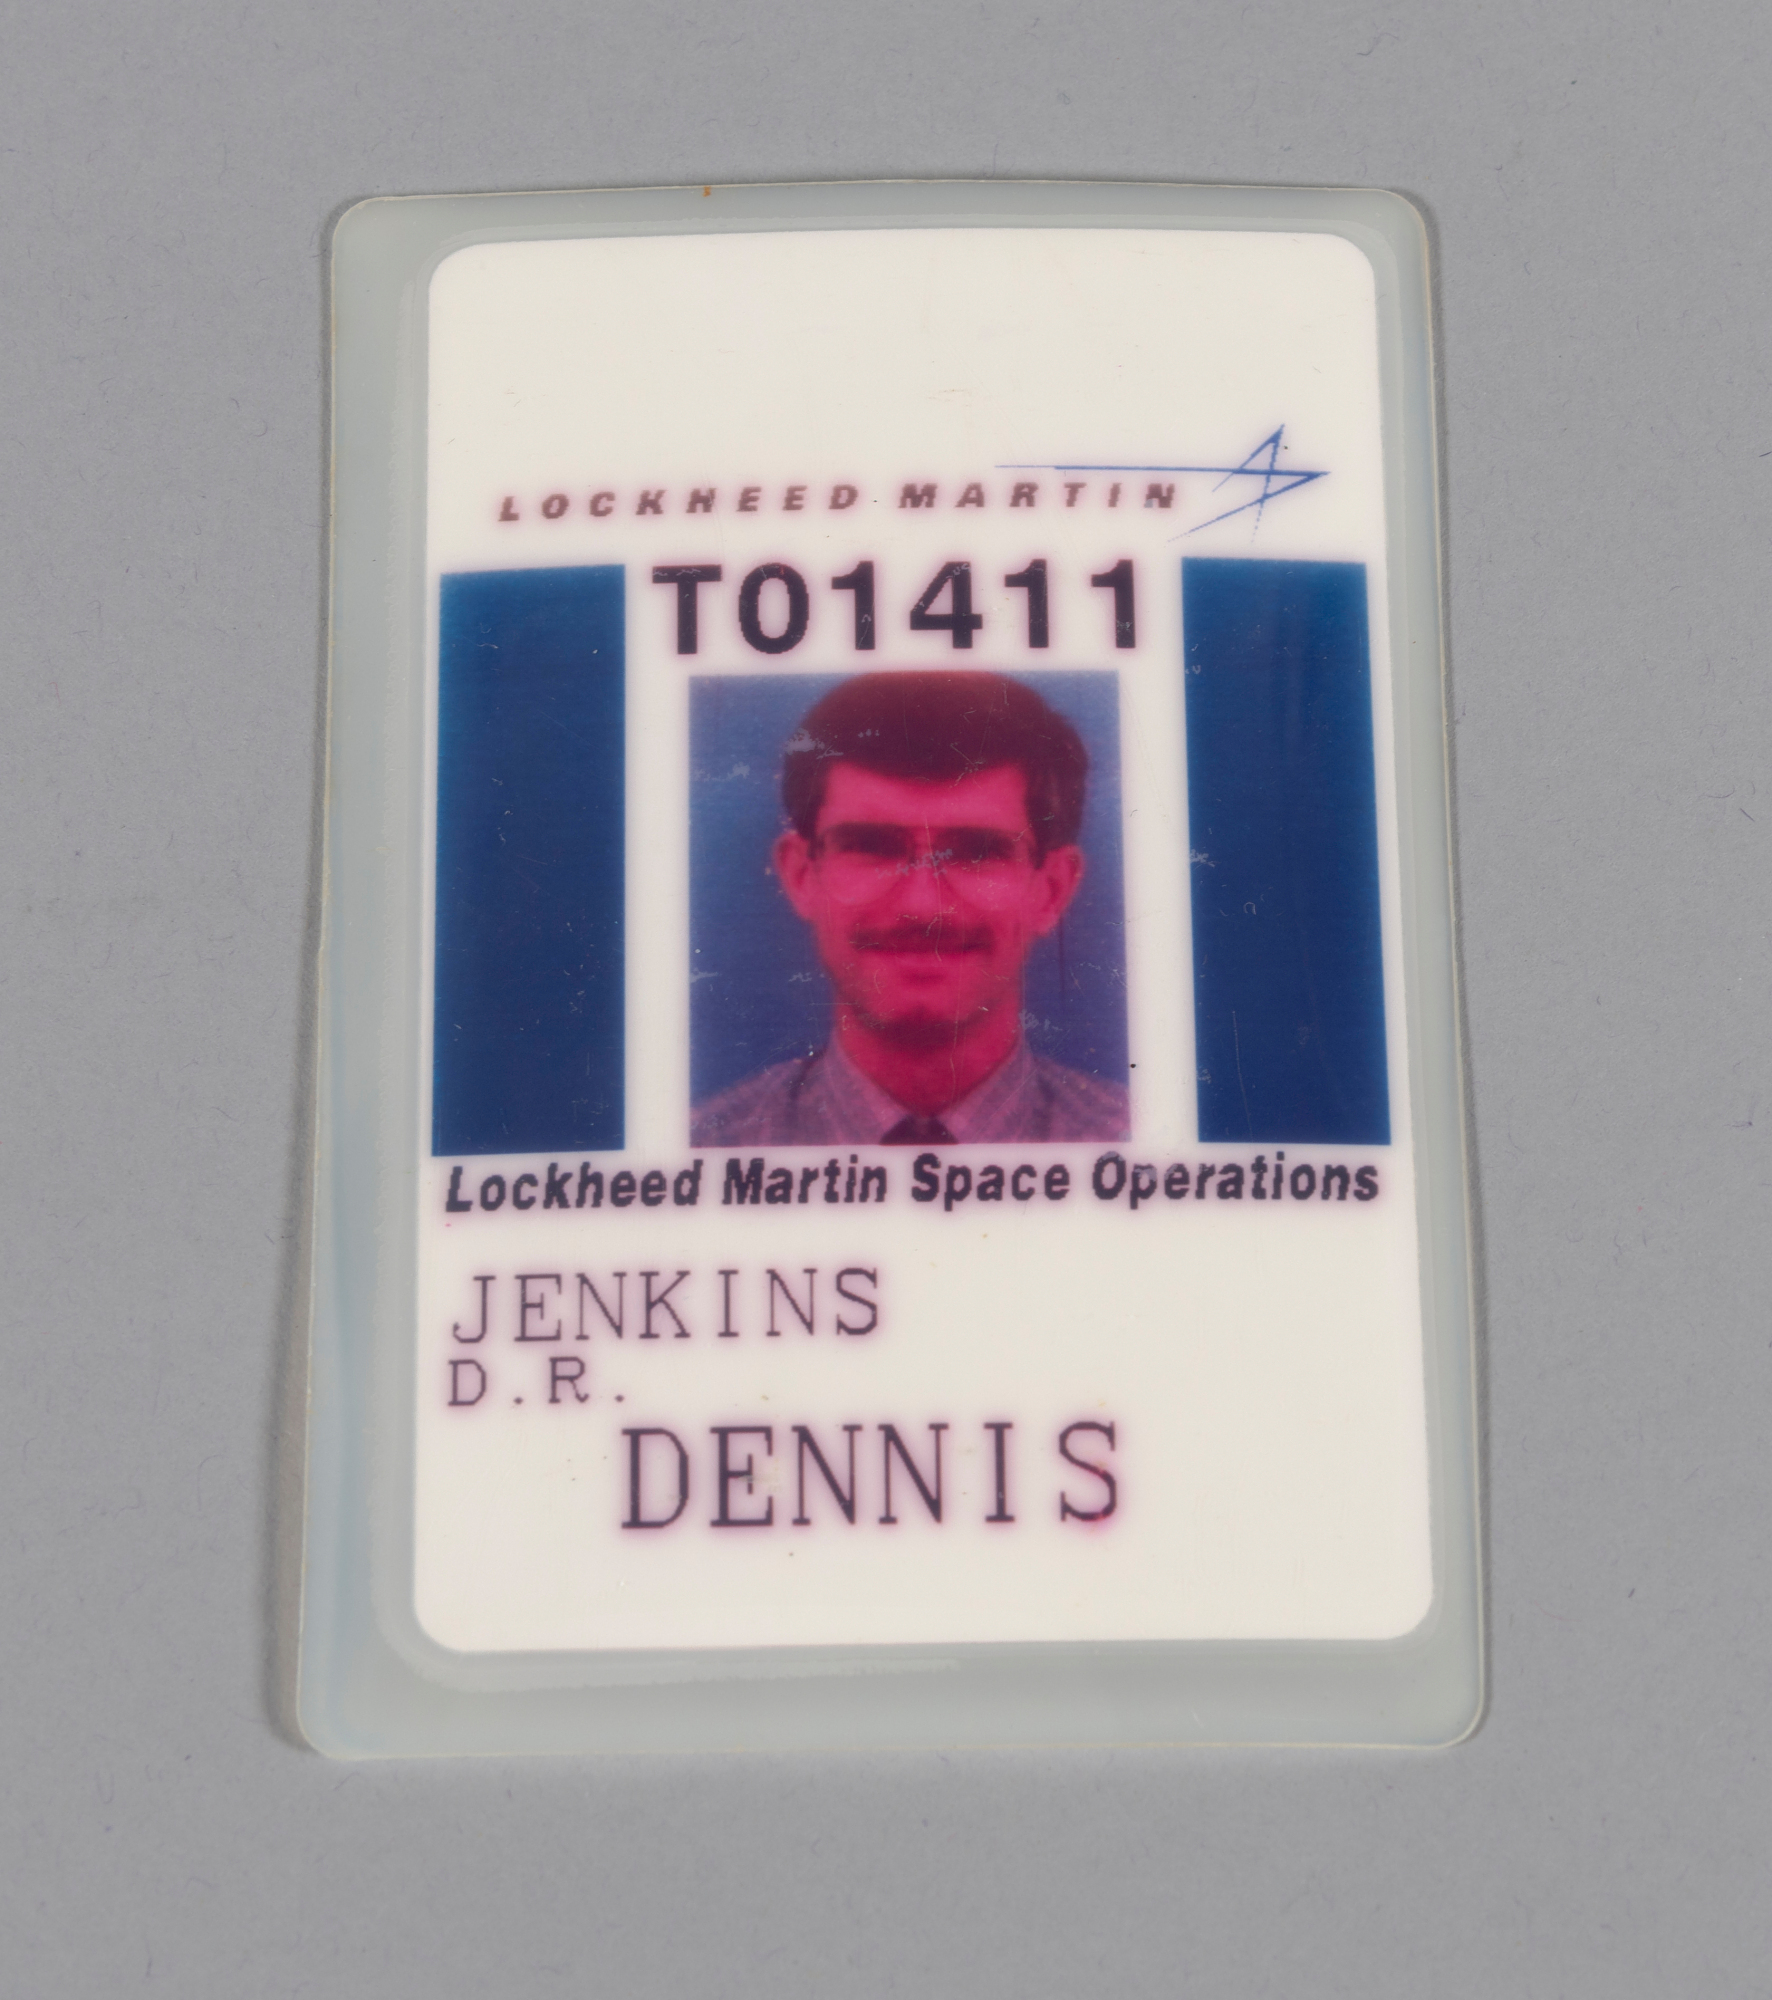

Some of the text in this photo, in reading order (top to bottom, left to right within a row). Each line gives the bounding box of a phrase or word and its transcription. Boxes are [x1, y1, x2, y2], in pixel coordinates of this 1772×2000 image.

[498, 482, 1176, 523] LOCKHEED MARTIN
[651, 558, 1137, 656] T01411
[444, 1150, 1380, 1214] Lockheed Martin Space Operations
[451, 1267, 878, 1344] JENKINS
[447, 1355, 626, 1407] D.R.
[620, 1420, 1118, 1530] DENNIS
